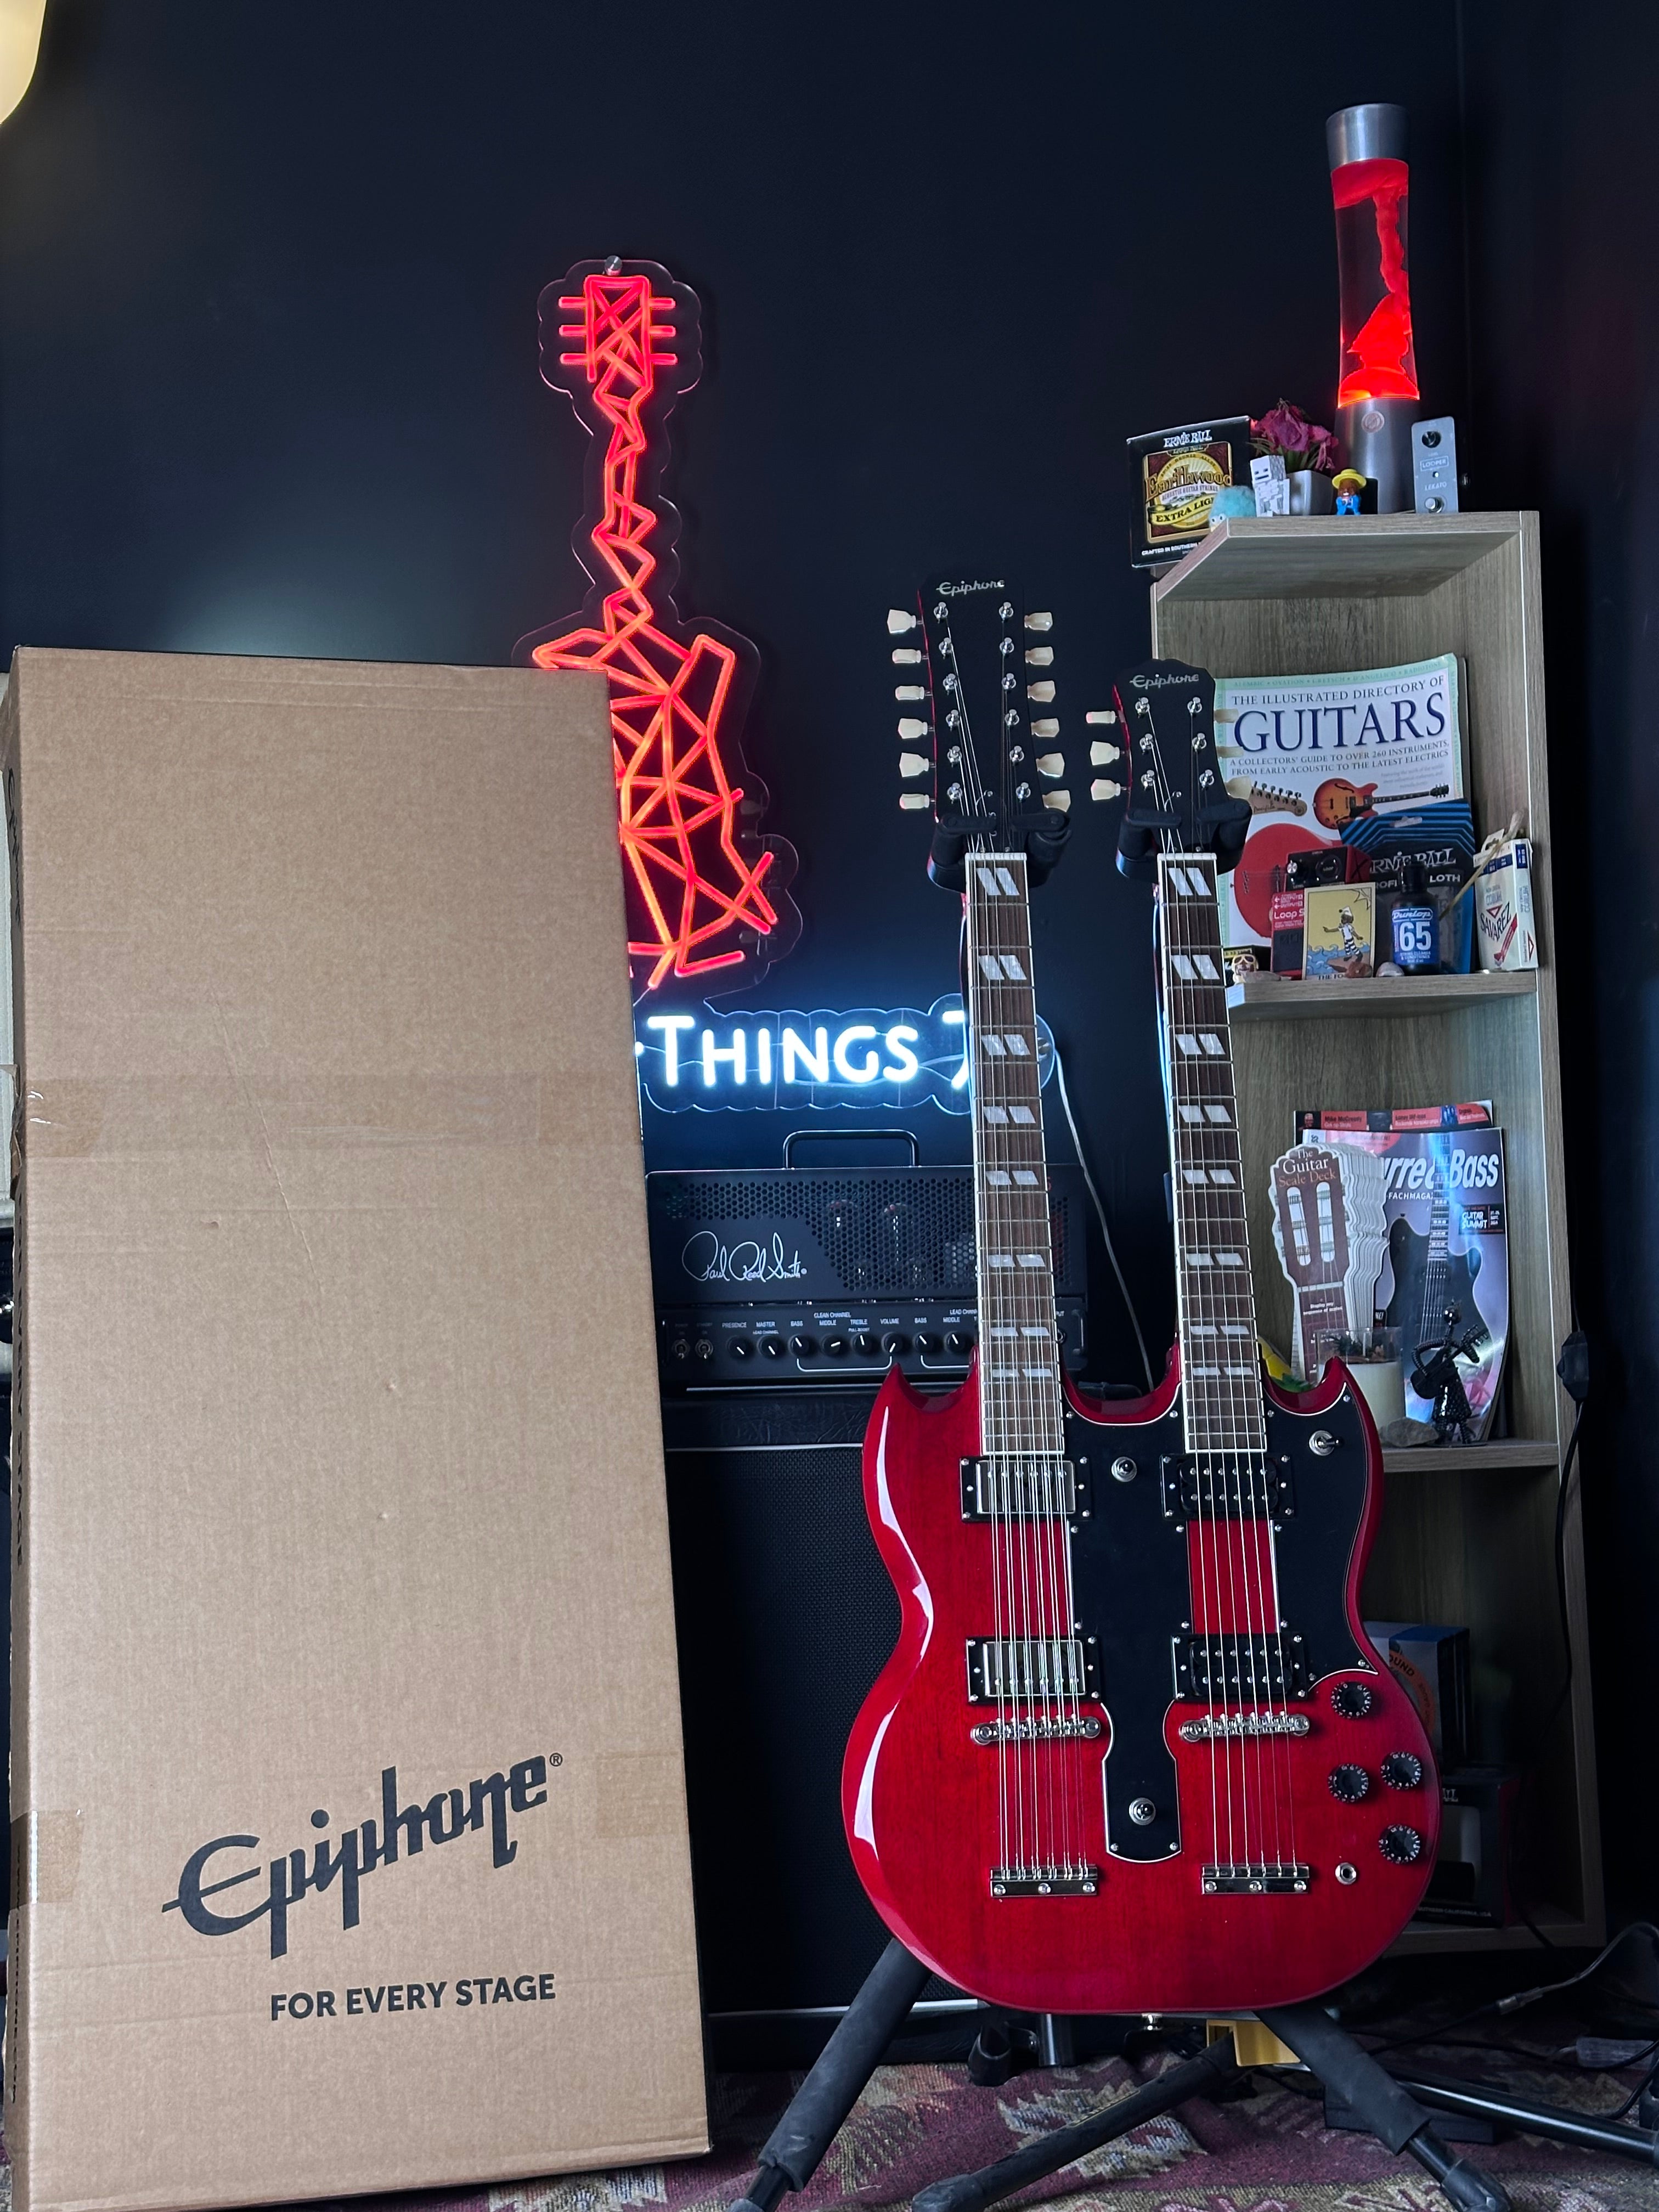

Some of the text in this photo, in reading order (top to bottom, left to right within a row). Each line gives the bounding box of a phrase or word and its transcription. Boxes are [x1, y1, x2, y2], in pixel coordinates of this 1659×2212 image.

[1163, 430, 1213, 448] ERNIE BALL
[1146, 464, 1233, 501] Earthwood
[1156, 508, 1192, 522] EXTRA
[936, 580, 1005, 597] Epiphone
[1129, 674, 1199, 690] Epiphone
[1232, 675, 1444, 706] THE ILLUSTRATED DIRECTORY OF
[1234, 692, 1446, 752] GUITARS
[1232, 750, 1449, 776] FROM EARLY ACOUSTIC TO THE LATEST ELECTRICS
[1238, 756, 1299, 766] COLLECTORS'
[1301, 754, 1327, 763] GUIDE
[1345, 751, 1370, 761] OVER
[1372, 750, 1387, 758] 260
[1389, 740, 1449, 756] INSTRUMENTS,
[1370, 851, 1412, 874] RNIE
[1429, 874, 1461, 883] LOTH
[1274, 911, 1297, 920] Loop
[1392, 911, 1432, 919] Dunlop
[1481, 901, 1511, 942] SAVAREZ
[1400, 921, 1432, 951] 65
[646, 1015, 919, 1087] THINGS
[1297, 1148, 1313, 1159] The
[1283, 1158, 1329, 1175] Guitar
[1450, 1149, 1499, 1188] Bass
[1278, 1168, 1336, 1188] Scale Deck
[1388, 1192, 1434, 1200] FACHMAGA
[1462, 1211, 1484, 1220] GUITAR
[1462, 1220, 1488, 1229] SUMMIT
[682, 1231, 730, 1282] Paul
[765, 1232, 802, 1279] Smith
[161, 1755, 548, 1960] Epiphone
[270, 1973, 556, 2021] FOR EVERY STAGE
